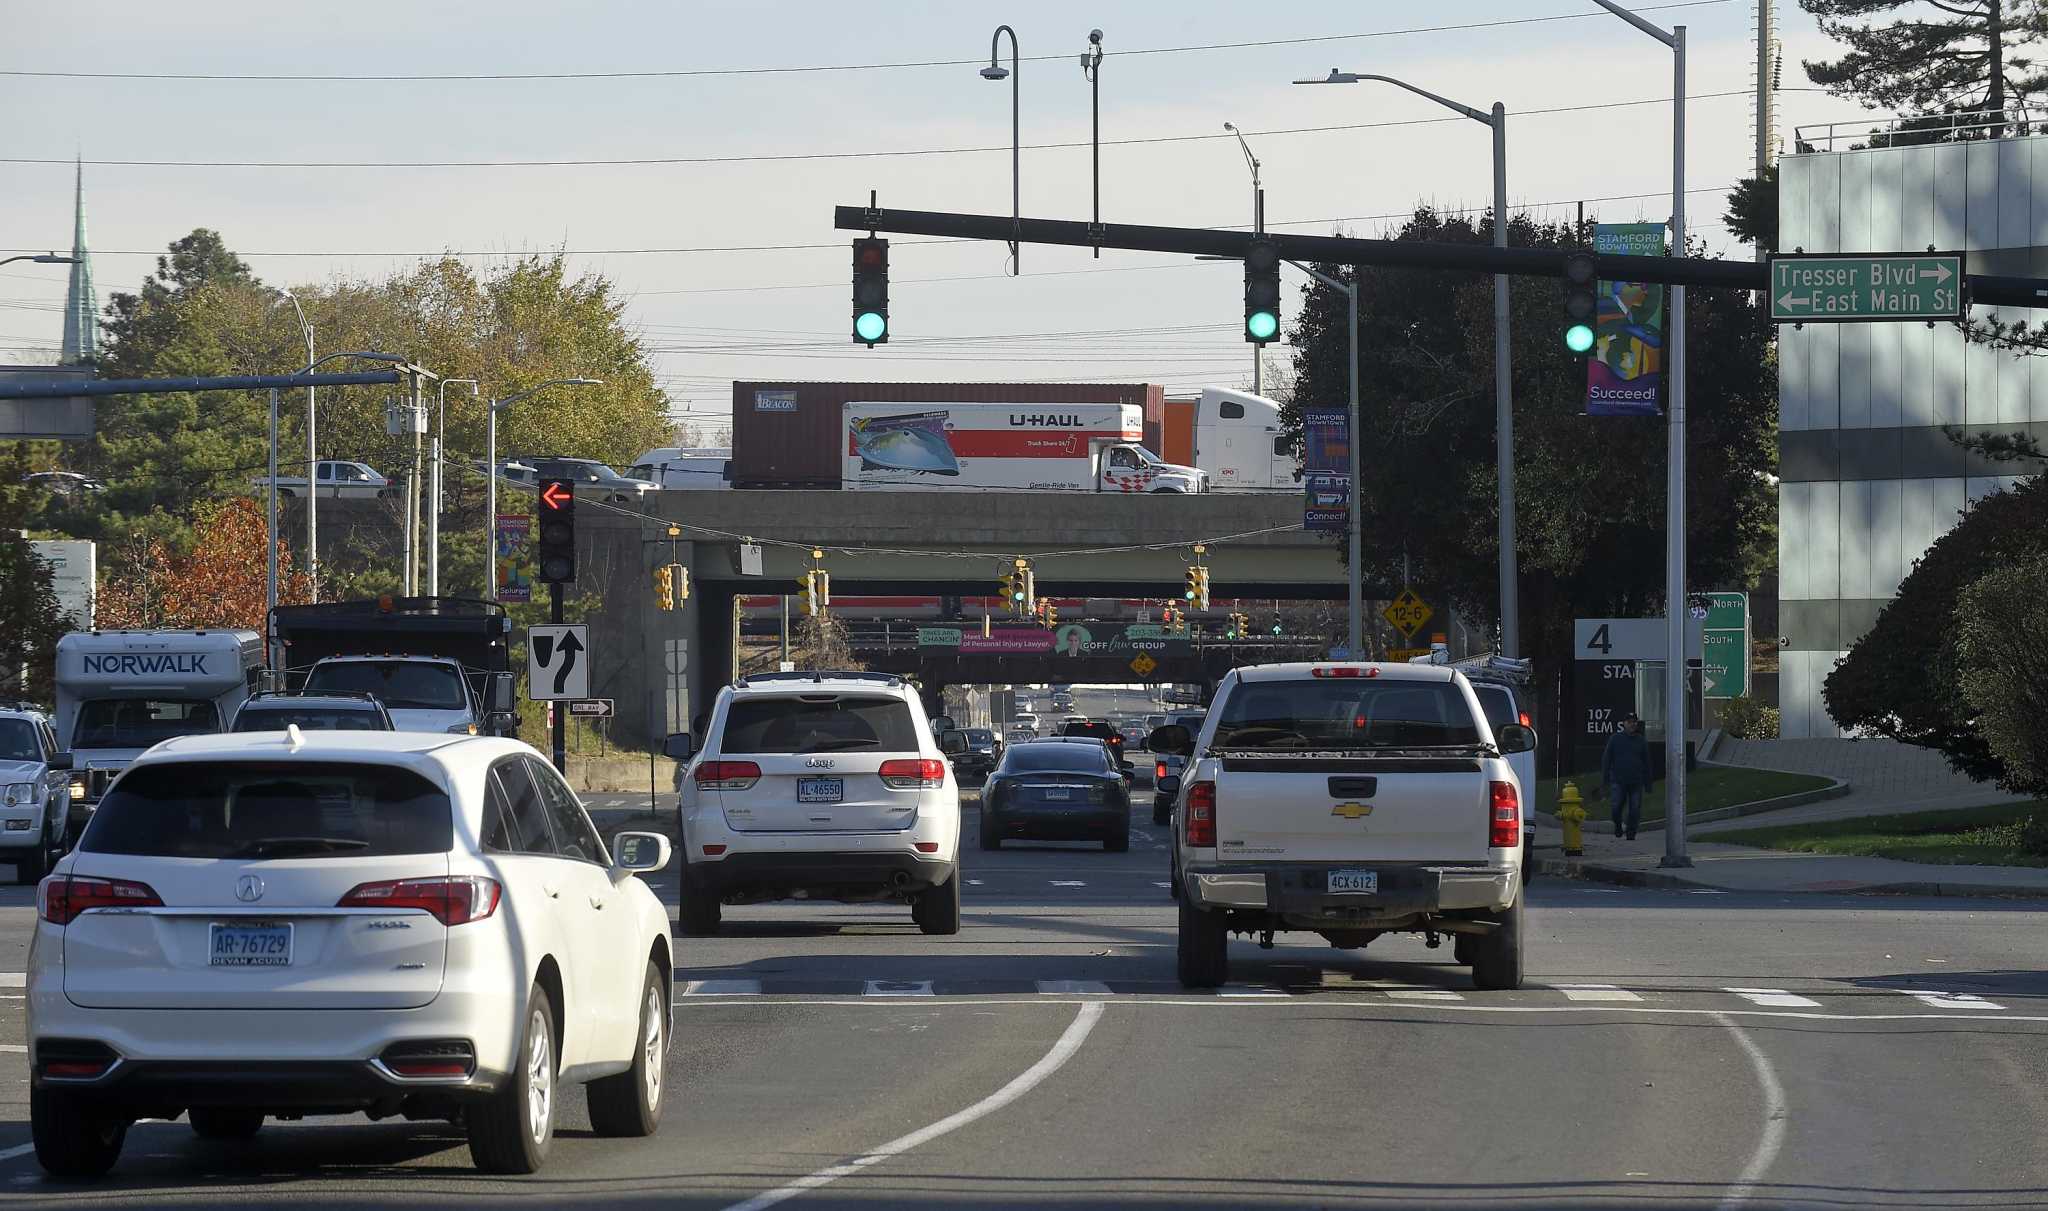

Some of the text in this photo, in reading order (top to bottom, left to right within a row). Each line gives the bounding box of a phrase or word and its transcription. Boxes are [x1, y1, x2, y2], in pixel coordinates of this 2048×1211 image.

[1598, 233, 1660, 243] STAMFORD
[1778, 263, 1916, 287] Tresser Blvd
[1812, 288, 1954, 312] East Main St
[1590, 386, 1656, 400] Succeed!
[1009, 414, 1084, 427] U-HAUL
[1306, 511, 1346, 521] Connect!
[1393, 607, 1423, 620] 12-6
[1690, 607, 1707, 619] 95
[1002, 641, 1022, 649] Injury
[1586, 623, 1613, 655] 4
[84, 654, 209, 676] NORWALK
[1587, 709, 1612, 720] 107
[1587, 721, 1613, 733] ELM
[806, 758, 835, 769] Jeep
[249, 957, 287, 965] ACURA
